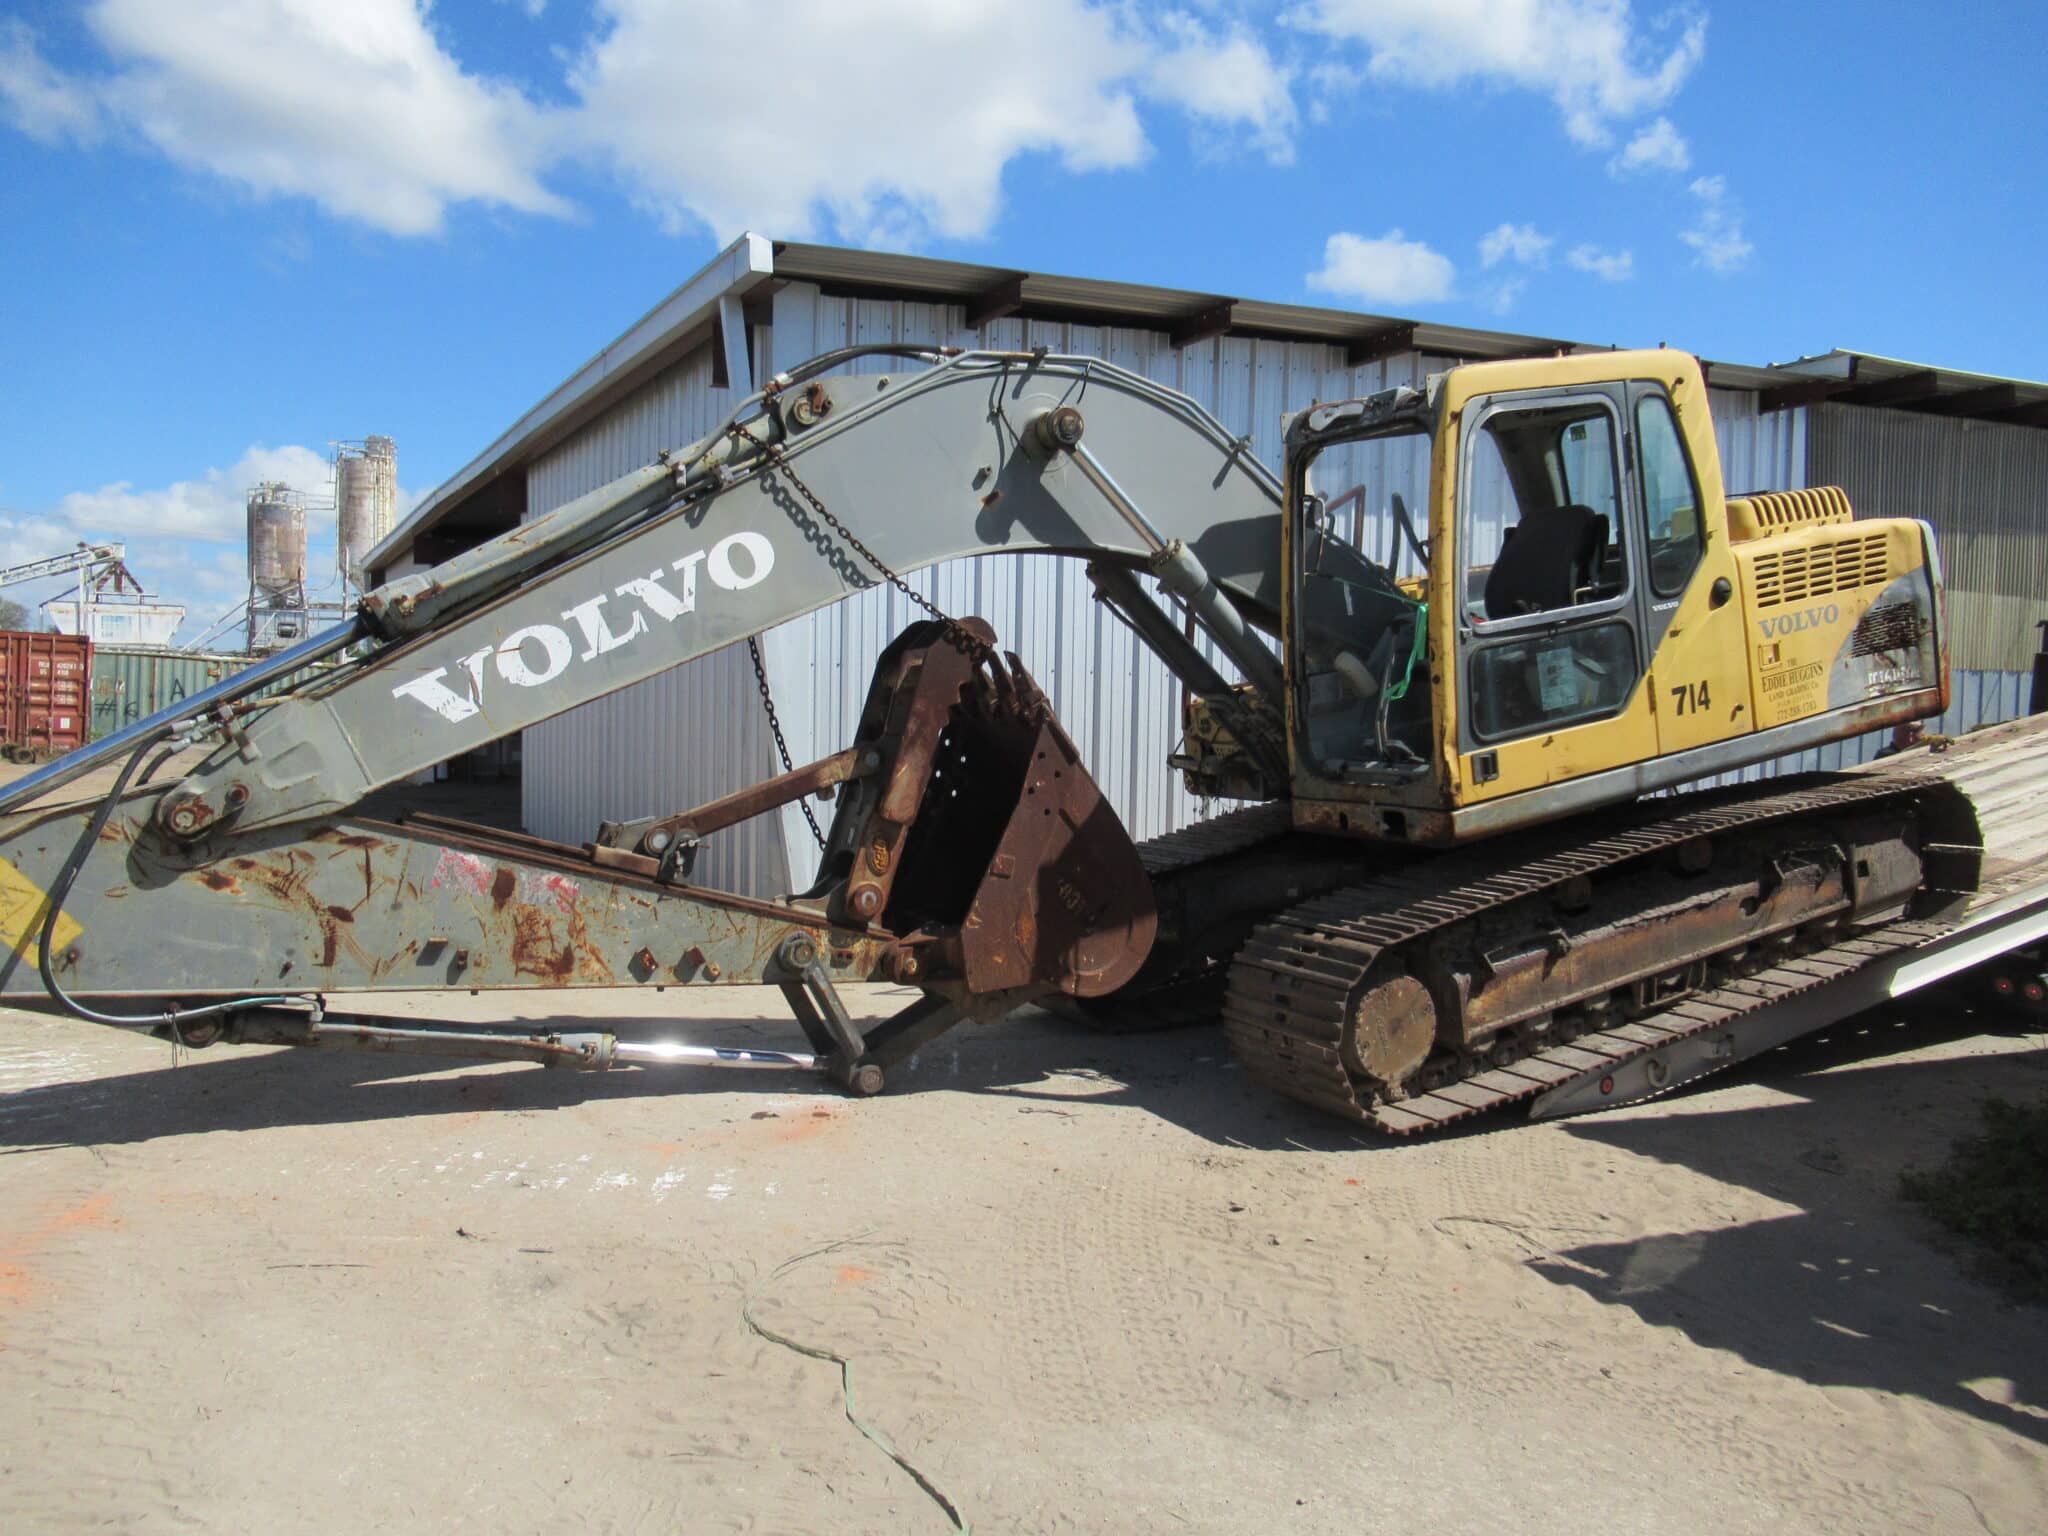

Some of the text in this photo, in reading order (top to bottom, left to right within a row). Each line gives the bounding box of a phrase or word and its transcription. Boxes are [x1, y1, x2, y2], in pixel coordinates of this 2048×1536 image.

[391, 531, 775, 723] VOLVO
[1758, 603, 1840, 639] VOLVO
[170, 678, 186, 701] A
[1761, 663, 1824, 693] EDDIE HUGGINS
[1671, 679, 1711, 716] 714
